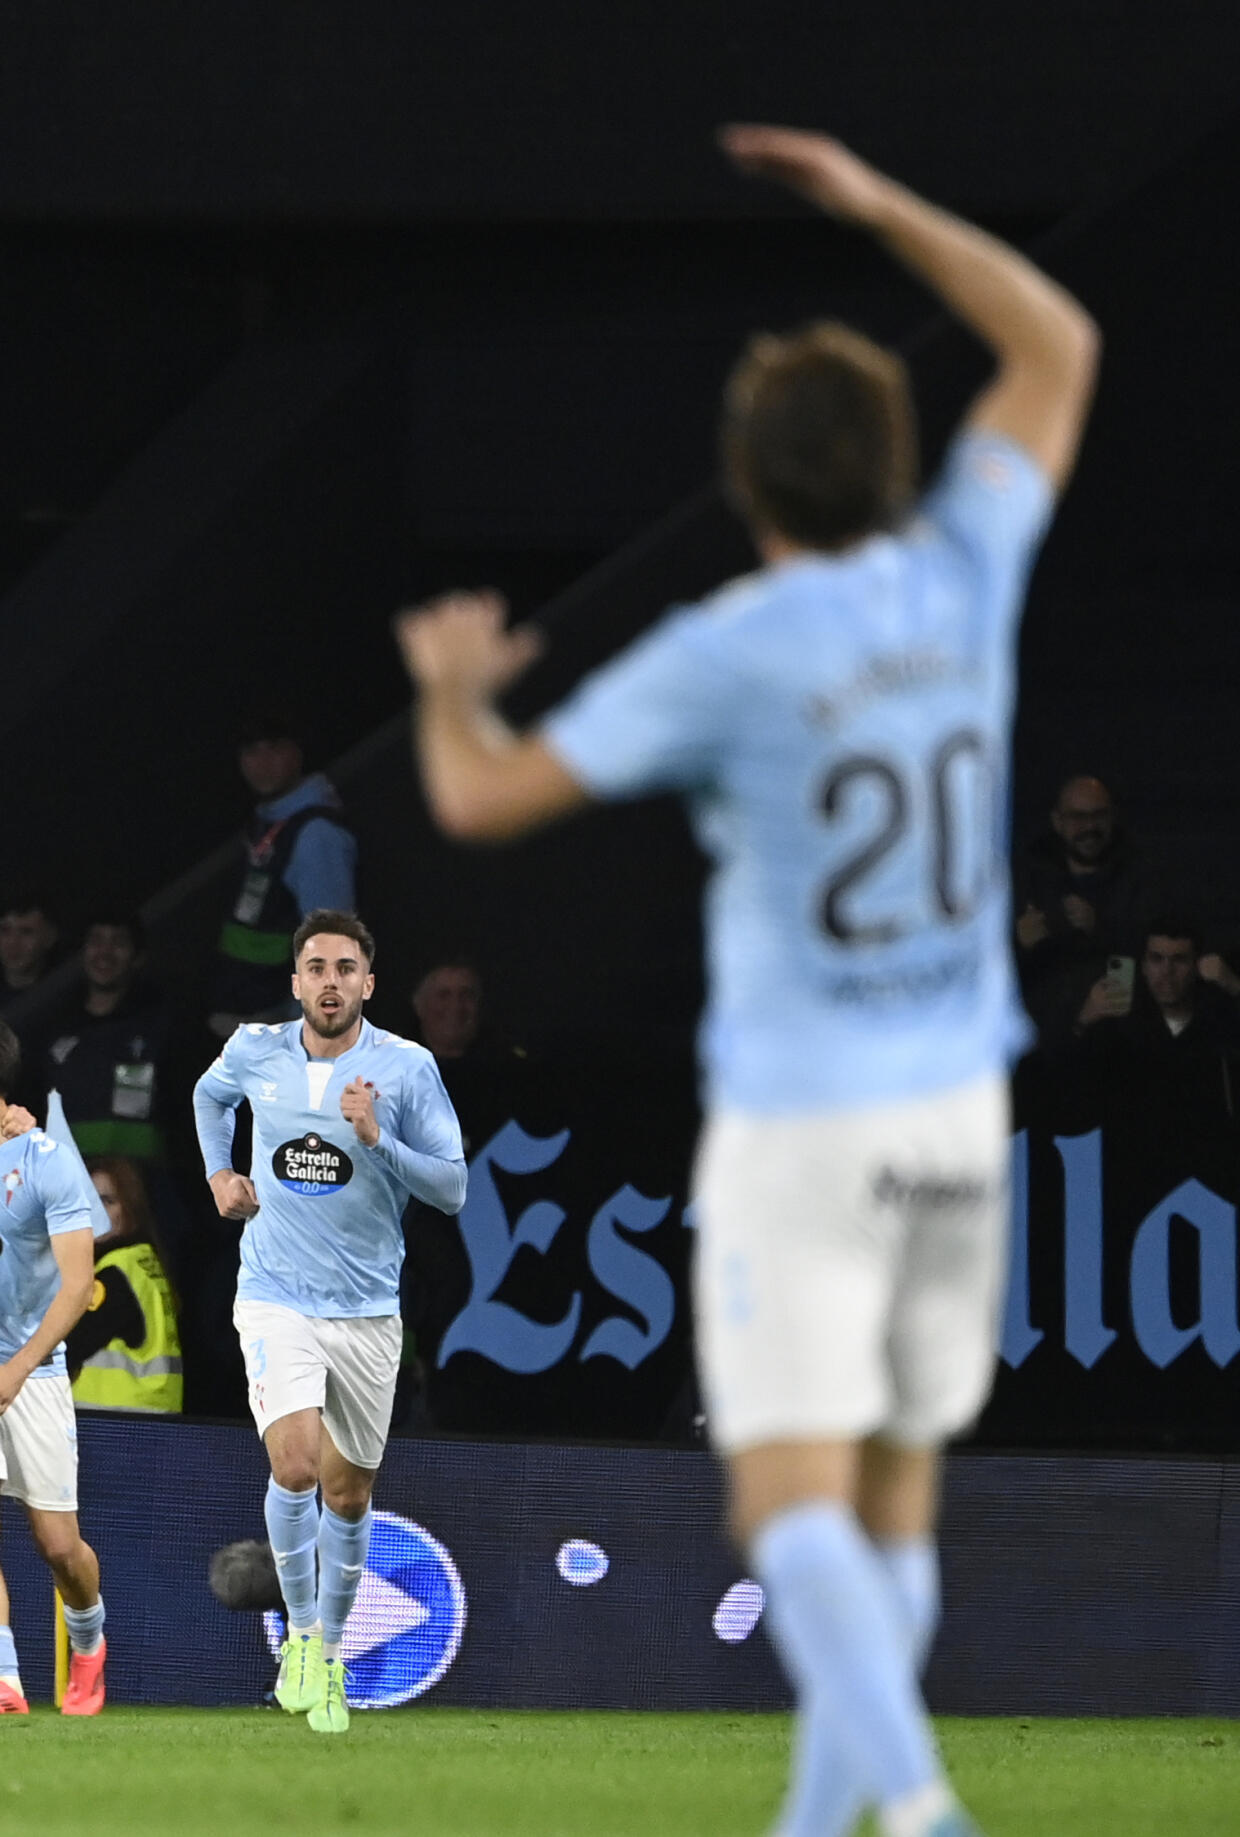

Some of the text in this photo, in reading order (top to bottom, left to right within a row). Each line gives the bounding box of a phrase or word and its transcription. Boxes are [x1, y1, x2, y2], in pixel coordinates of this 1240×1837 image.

[815, 724, 988, 945] 20
[284, 1147, 340, 1167] Estrella
[286, 1162, 337, 1182] Galicia
[436, 1117, 1240, 1374] Eslla
